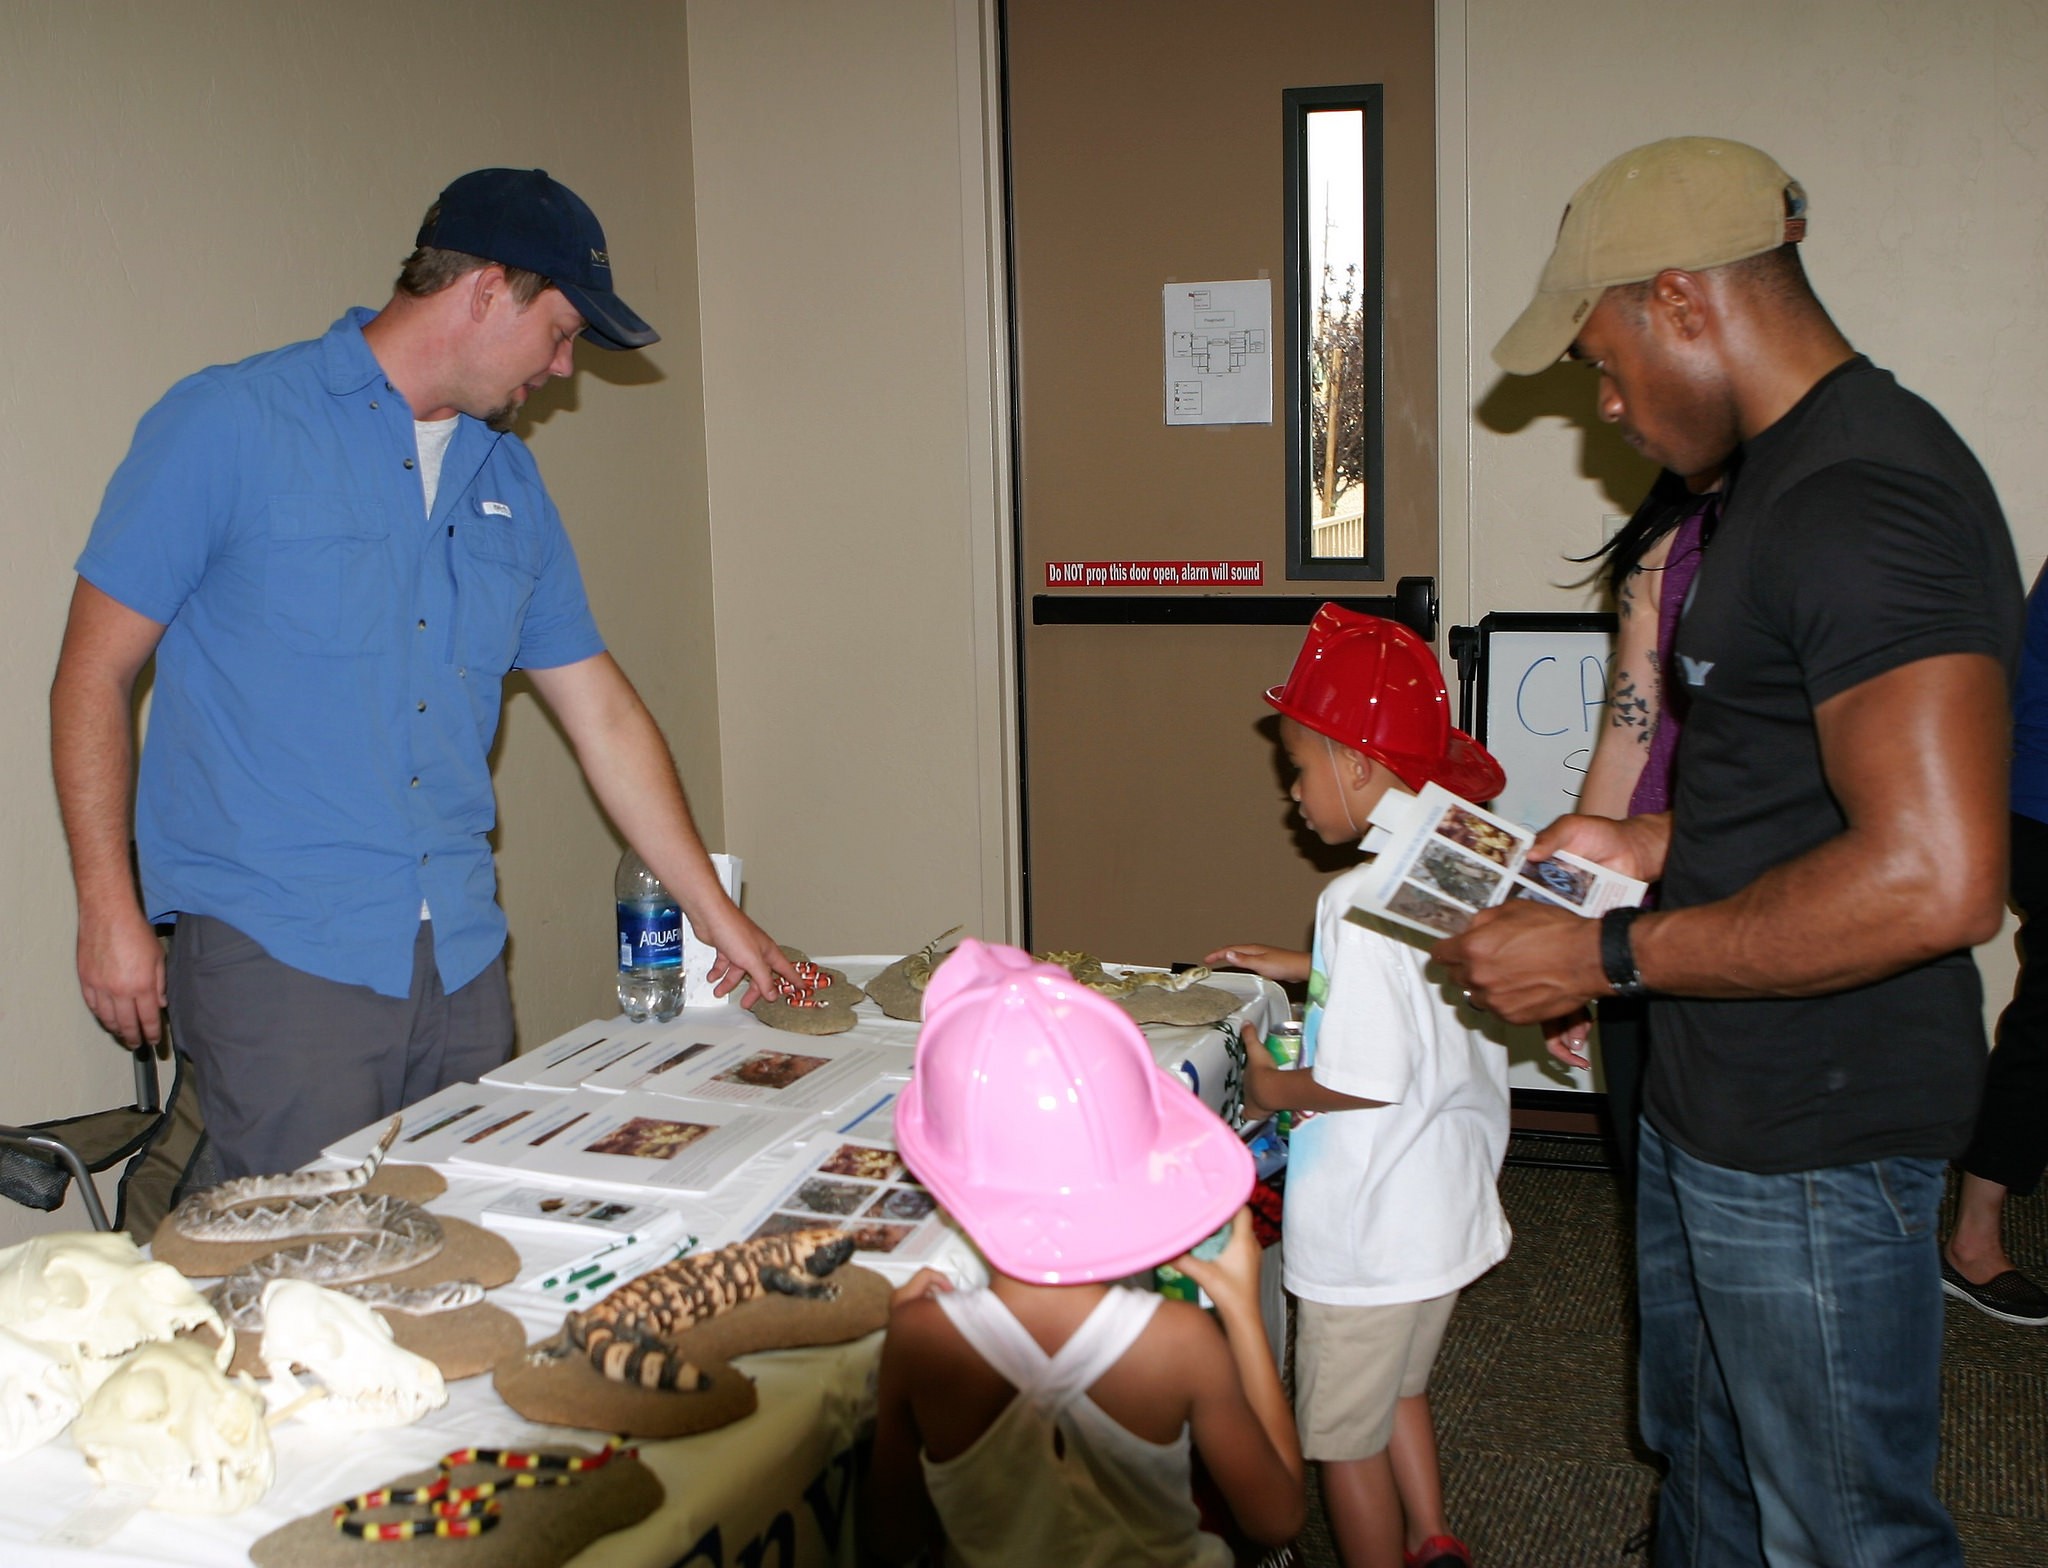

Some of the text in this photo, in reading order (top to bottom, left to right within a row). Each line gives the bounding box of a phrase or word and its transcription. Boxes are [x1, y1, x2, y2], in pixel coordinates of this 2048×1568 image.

[1049, 562, 1260, 586] Do NOT prop this door open, alarm will sound
